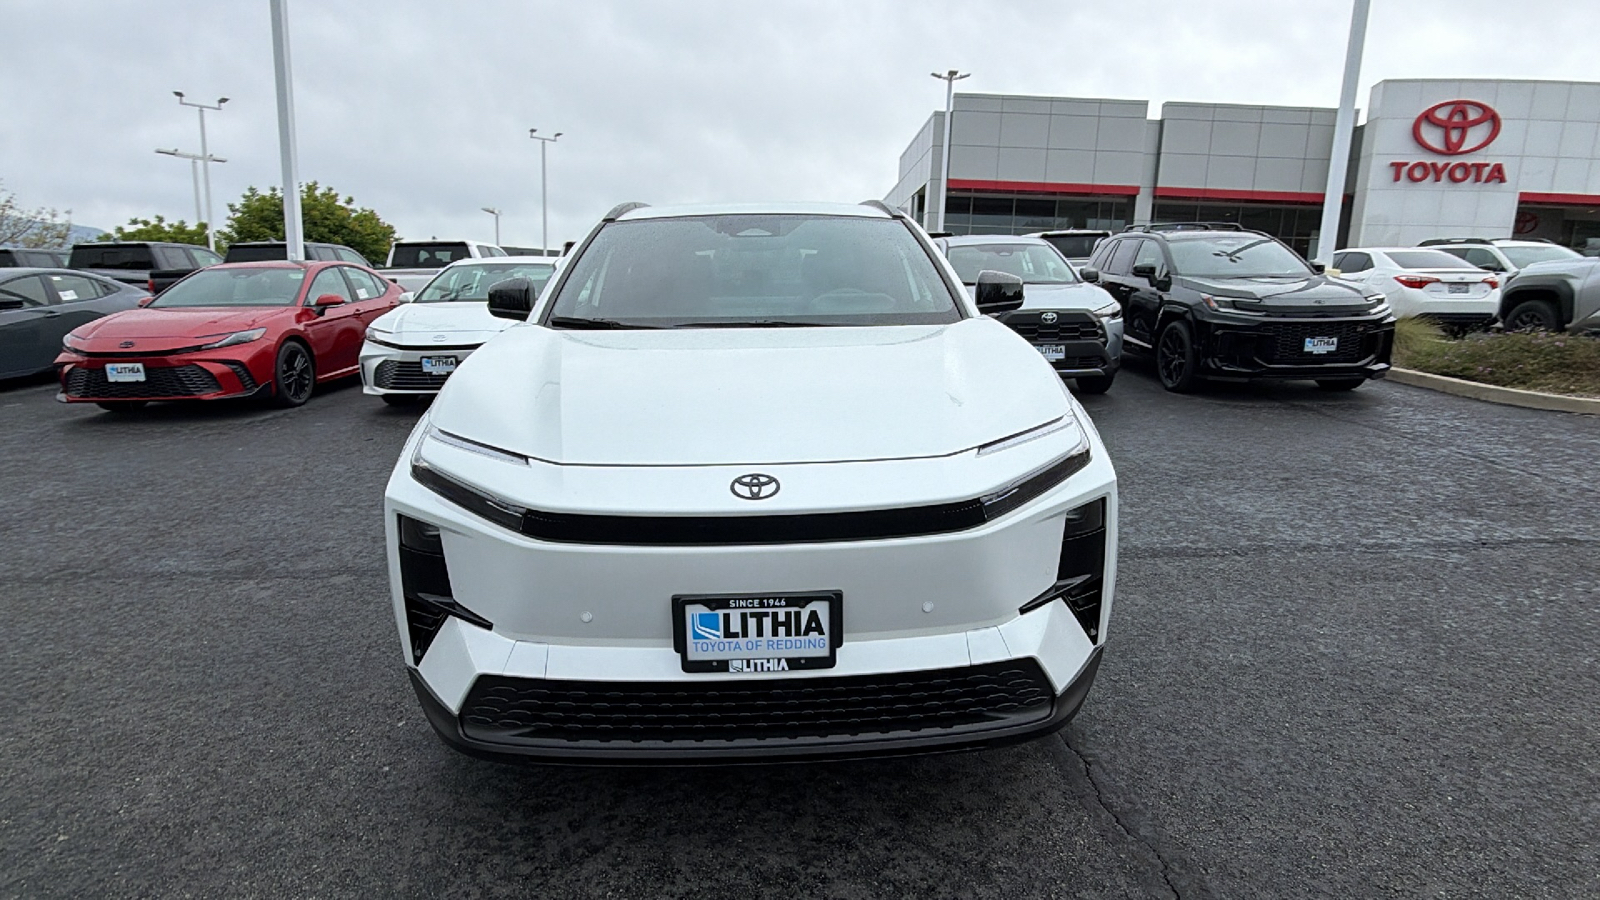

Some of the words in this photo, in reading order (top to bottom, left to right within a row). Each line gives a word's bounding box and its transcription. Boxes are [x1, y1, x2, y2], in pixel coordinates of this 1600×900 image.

[1390, 161, 1507, 183] TOYOTA
[1312, 339, 1336, 347] LITHIA
[430, 359, 455, 367] LITHIA
[116, 366, 142, 374] LITHIA
[729, 599, 760, 608] SINCE
[763, 598, 786, 607] 1946
[722, 610, 826, 638] LITHIA
[692, 641, 742, 653] TOYOTA
[746, 640, 763, 651] OF
[766, 638, 826, 650] REDDING
[742, 658, 789, 672] LITHIA
